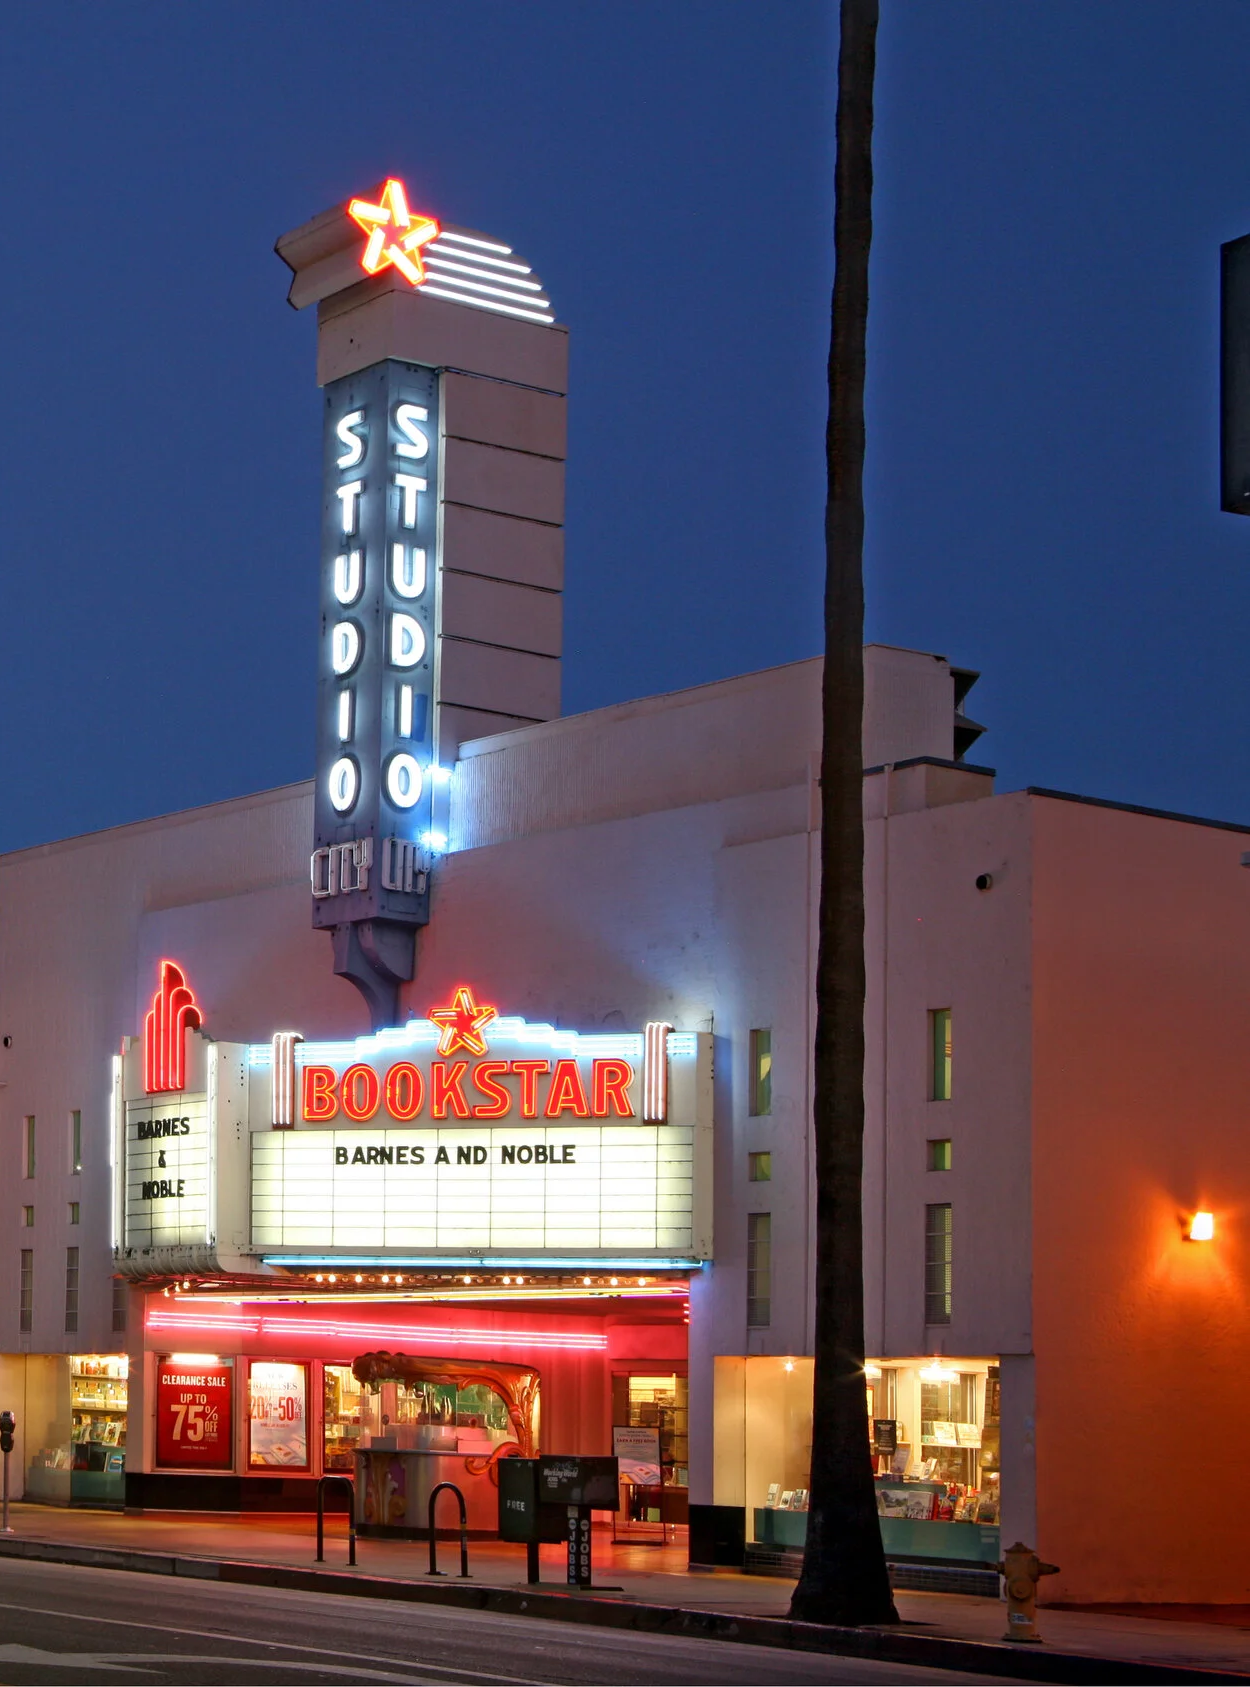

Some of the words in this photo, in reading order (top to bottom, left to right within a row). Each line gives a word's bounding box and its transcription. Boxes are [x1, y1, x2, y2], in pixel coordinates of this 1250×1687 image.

[329, 410, 365, 812] STUDIO
[386, 403, 429, 808] STUDIO
[302, 1058, 635, 1122] BOOKSTAR
[137, 1117, 190, 1138] BARNES
[158, 1149, 166, 1169] &
[335, 1145, 425, 1165] BARNES
[500, 1144, 577, 1164] NOBLE
[142, 1178, 185, 1199] NOBLE
[162, 1375, 206, 1386] CLEARANCE
[207, 1377, 226, 1387] SALE
[180, 1393, 193, 1404] UP
[194, 1394, 207, 1404] TO
